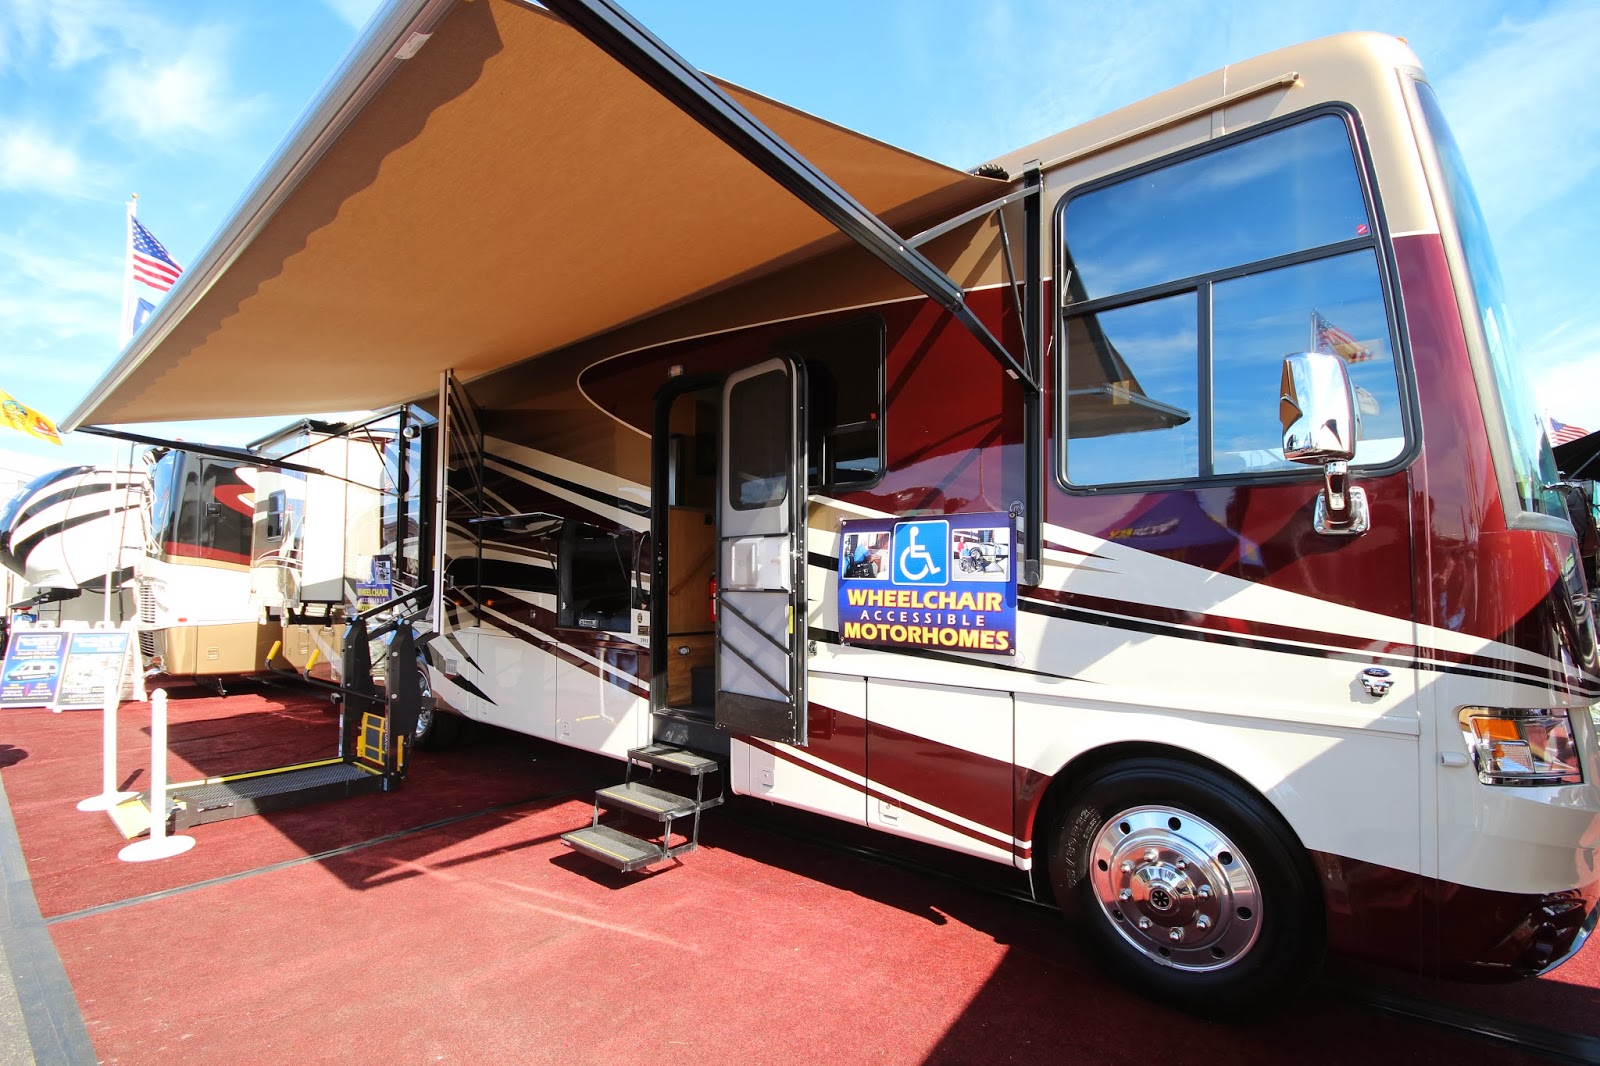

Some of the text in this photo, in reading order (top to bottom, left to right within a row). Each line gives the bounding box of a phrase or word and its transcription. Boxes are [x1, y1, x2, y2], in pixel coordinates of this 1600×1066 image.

[357, 588, 389, 597] WHEELCHAIR
[847, 588, 1003, 612] WHEELCHAIR
[860, 610, 985, 627] ACCESSIBLE
[844, 622, 1009, 650] MOTORHOMES
